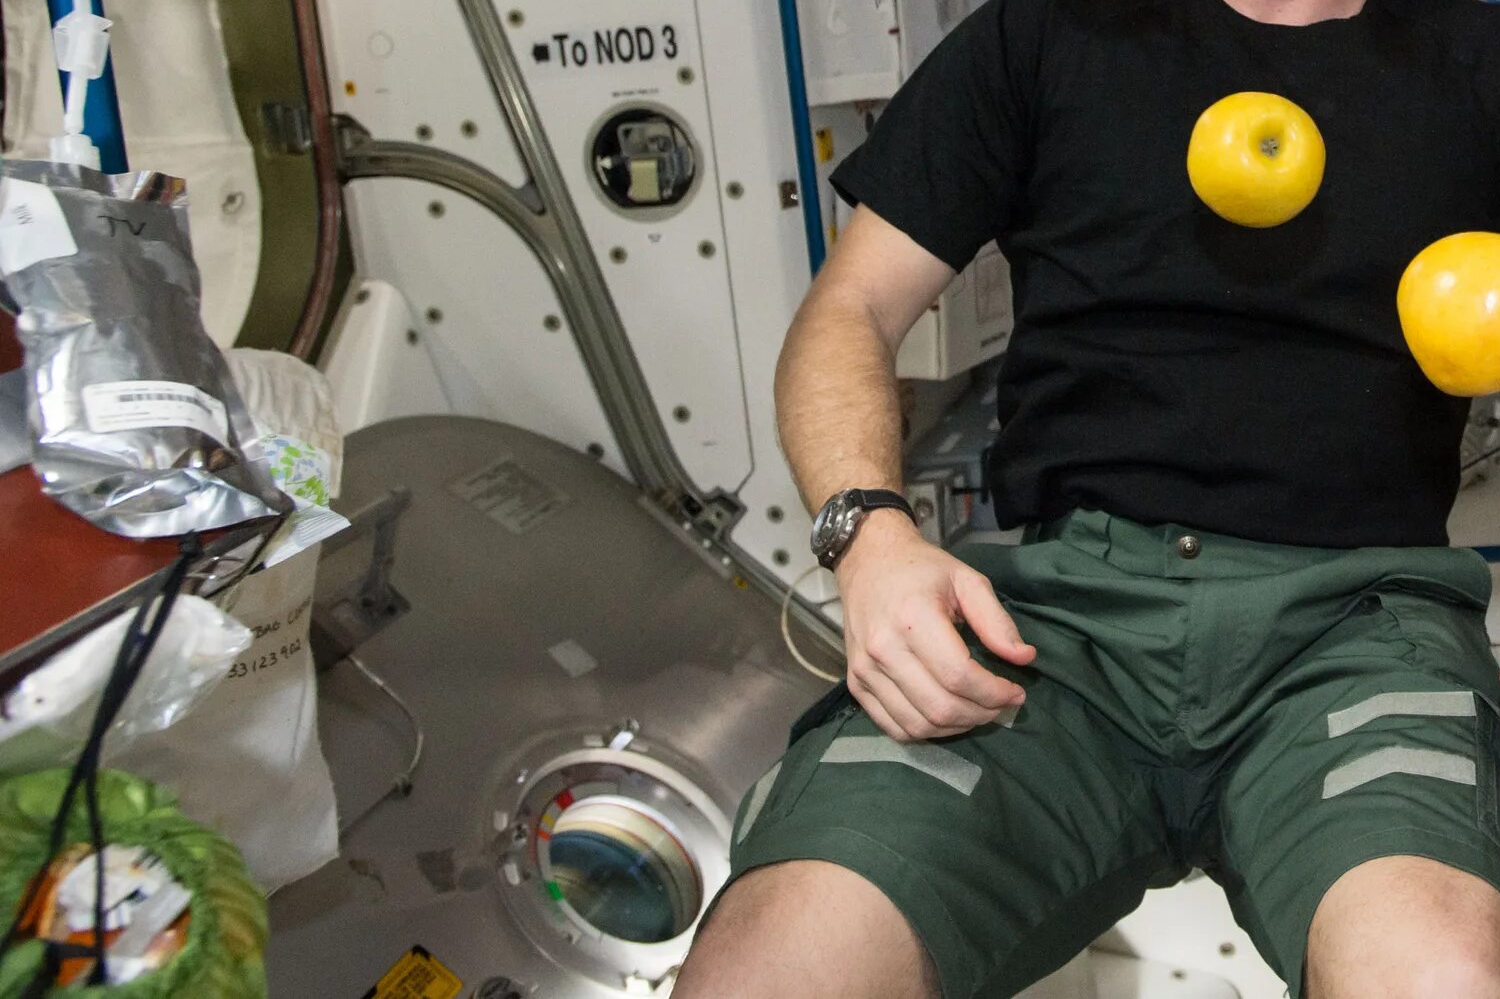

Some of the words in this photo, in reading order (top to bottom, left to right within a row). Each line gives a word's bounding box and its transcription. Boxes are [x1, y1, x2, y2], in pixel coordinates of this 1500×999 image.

[552, 33, 588, 68] To
[594, 26, 655, 65] NOD
[661, 24, 678, 60] 3
